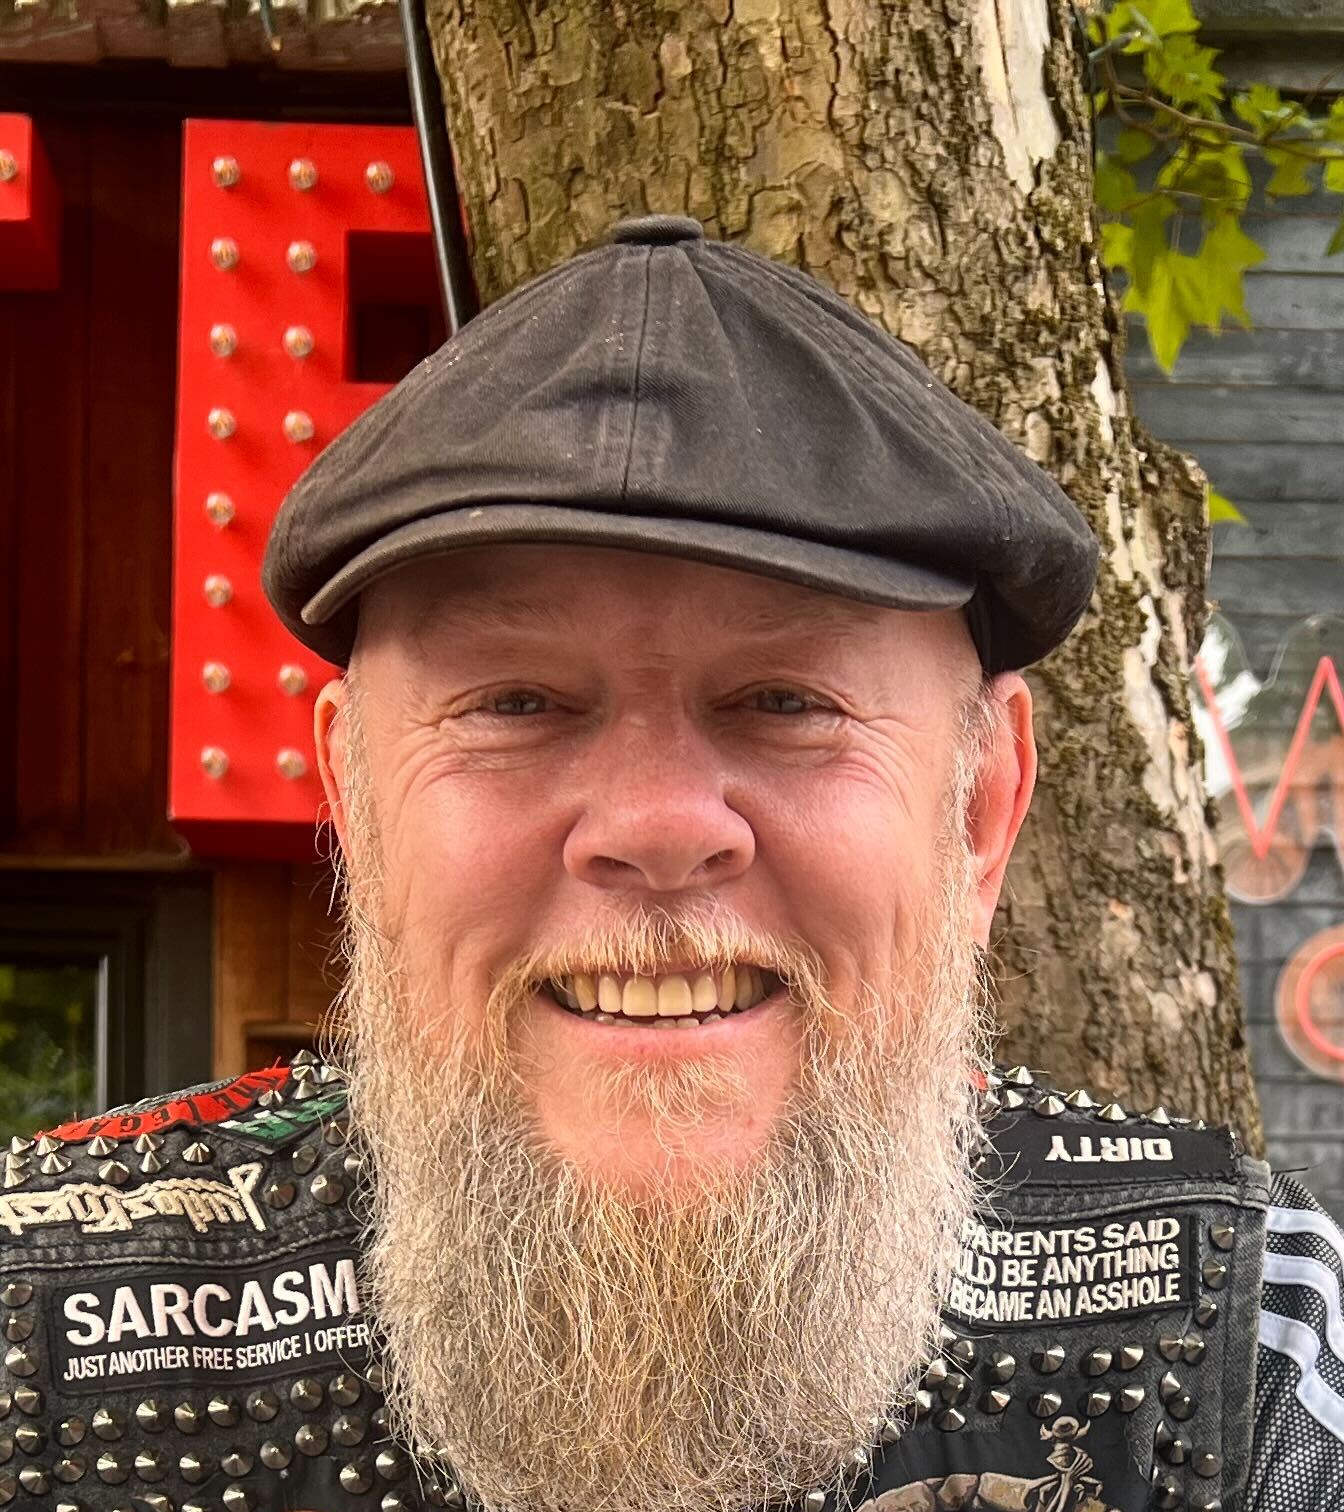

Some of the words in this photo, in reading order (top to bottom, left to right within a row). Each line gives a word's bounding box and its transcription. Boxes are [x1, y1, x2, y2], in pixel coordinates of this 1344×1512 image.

[1044, 1135, 1174, 1163] DIRTY
[960, 1217, 1097, 1257] PARENTS
[1101, 1217, 1181, 1248] SAID
[956, 1249, 997, 1287] ULD
[1001, 1259, 1038, 1287] BE
[1041, 1242, 1180, 1286] ANYTHING
[63, 1258, 362, 1347] SARCASM
[949, 1277, 1035, 1322] BECAME
[1036, 1288, 1072, 1320] AN
[1074, 1273, 1181, 1317] ASSHOLE
[63, 1353, 106, 1382] JUST
[108, 1345, 189, 1376] ANOTHER
[193, 1346, 234, 1372] FREE
[235, 1335, 302, 1369] SERVICE
[304, 1333, 312, 1356] I
[314, 1323, 372, 1354] OFFER
